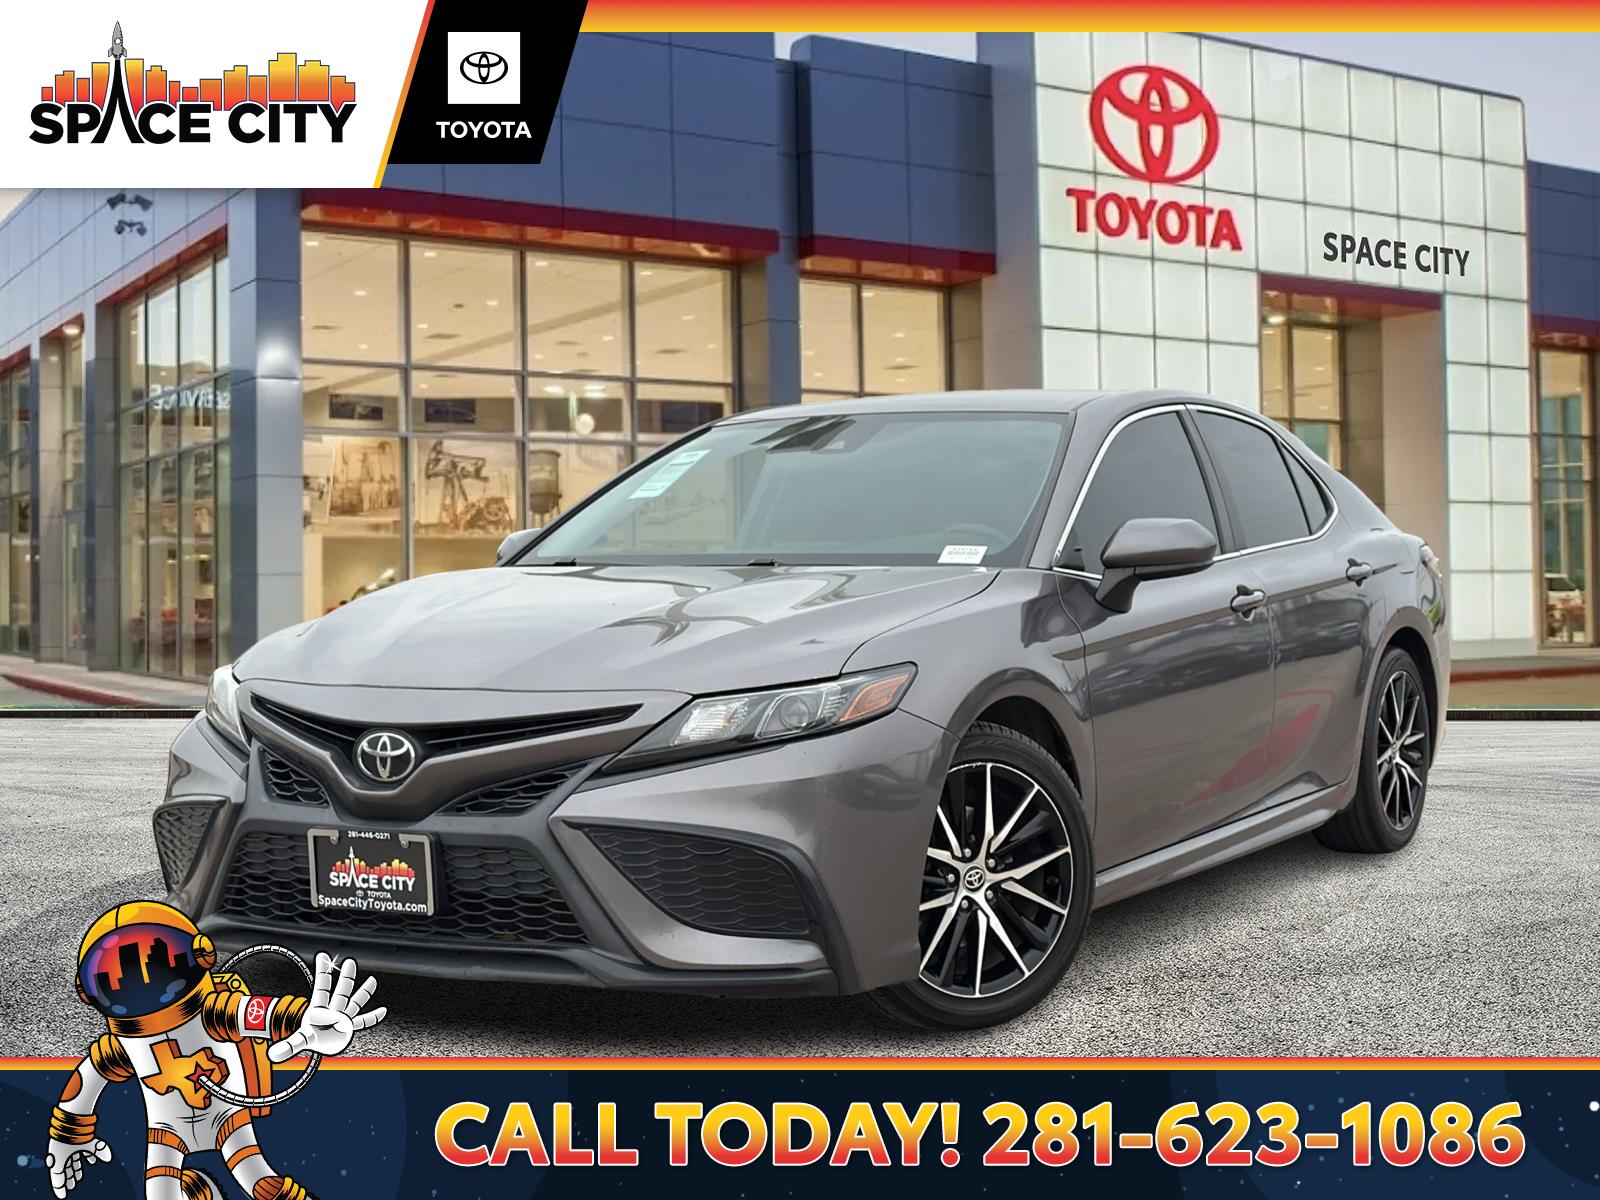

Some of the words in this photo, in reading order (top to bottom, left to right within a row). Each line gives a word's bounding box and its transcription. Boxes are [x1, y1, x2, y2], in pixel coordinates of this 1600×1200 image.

[1066, 187, 1242, 251] TOYOTA
[1323, 232, 1407, 270] SPACE
[1414, 243, 1470, 277] CITY
[329, 871, 379, 889] SPACE
[381, 875, 416, 892] CITY
[318, 895, 427, 912] SpaceCityToyota.com
[367, 890, 391, 899] TOYOTA
